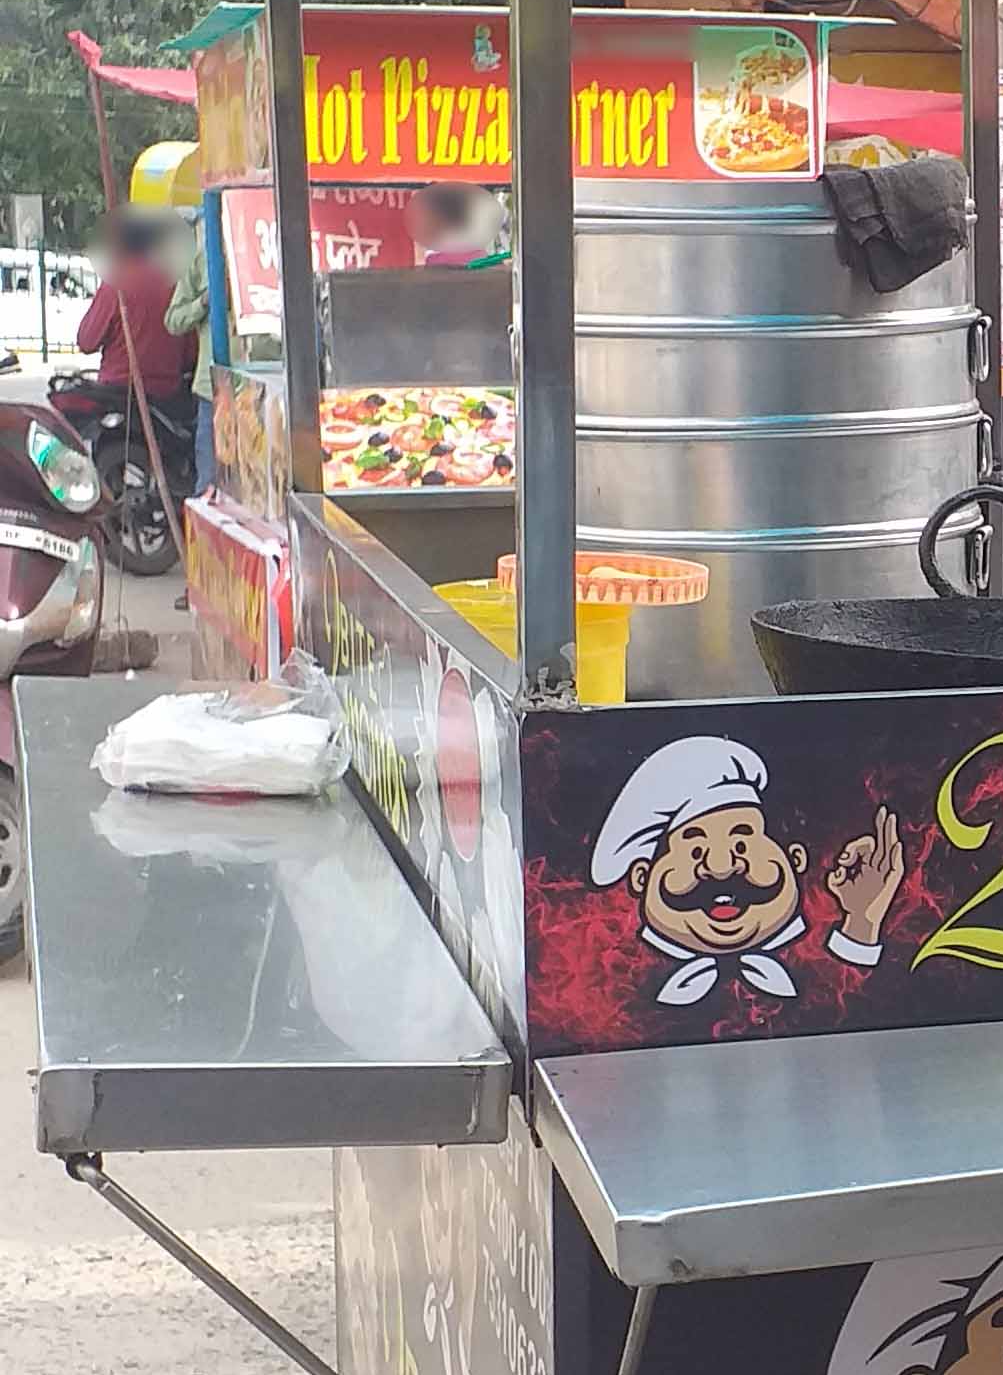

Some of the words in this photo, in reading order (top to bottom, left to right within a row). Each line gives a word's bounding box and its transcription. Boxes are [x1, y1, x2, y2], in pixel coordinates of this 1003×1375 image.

[380, 57, 511, 166] Pizza
[572, 81, 676, 167] rner
[339, 599, 378, 706] BITE
